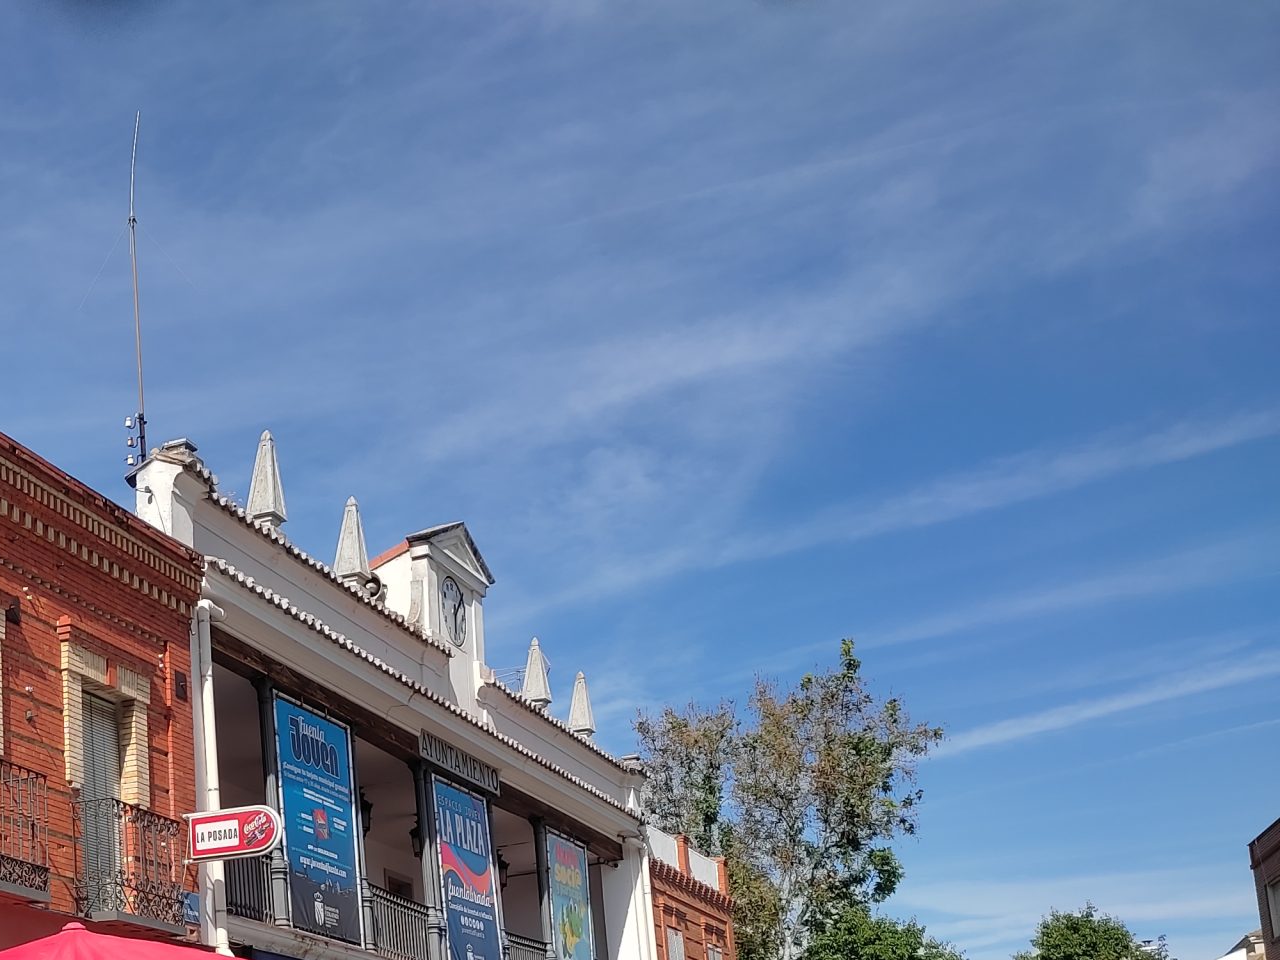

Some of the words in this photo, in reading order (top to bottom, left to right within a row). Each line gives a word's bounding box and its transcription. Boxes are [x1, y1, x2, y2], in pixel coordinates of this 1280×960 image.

[421, 731, 499, 792] AYUNTAMIENTO
[196, 832, 205, 844] LA
[208, 828, 238, 843] POSADA
[439, 806, 455, 845] LA
[455, 813, 486, 857] PLAZA
